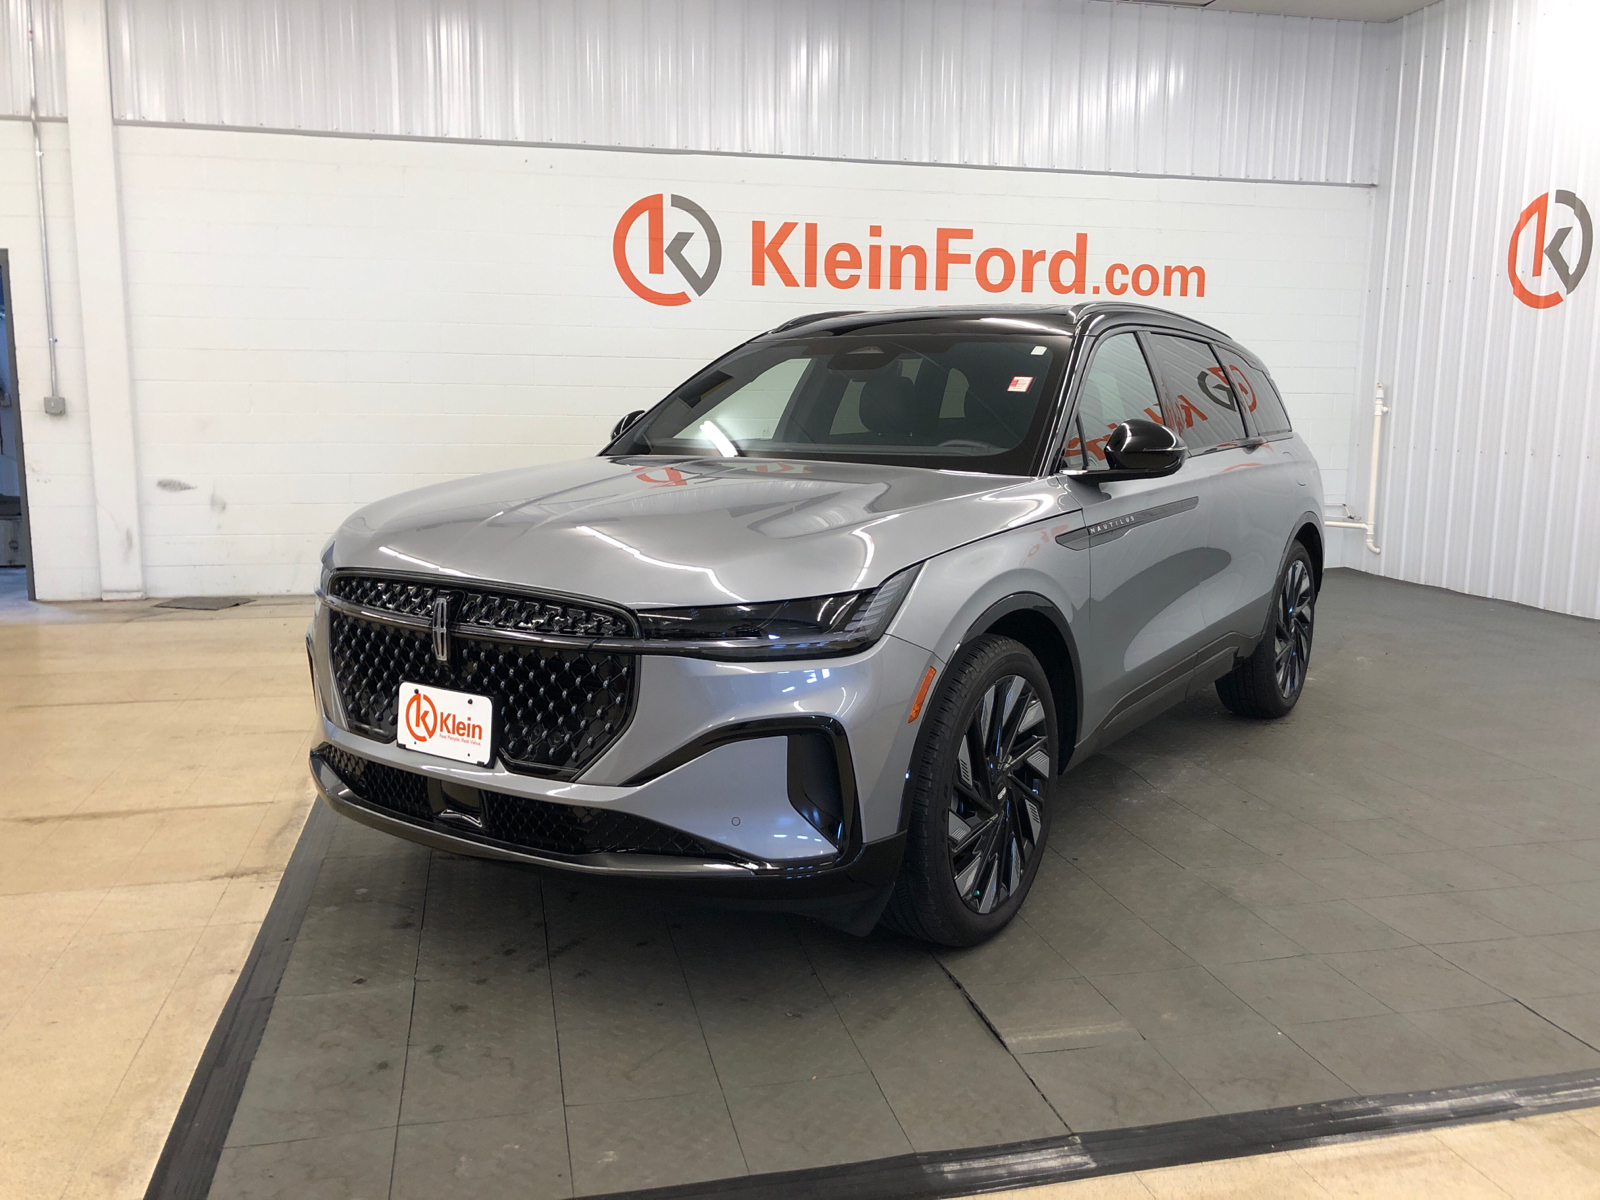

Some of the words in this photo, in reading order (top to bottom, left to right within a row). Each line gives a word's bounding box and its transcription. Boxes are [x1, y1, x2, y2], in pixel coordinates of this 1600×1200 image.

[751, 220, 1206, 298] KleinFord.com
[1090, 515, 1135, 534] NAUTILUS
[440, 711, 483, 740] Klein
